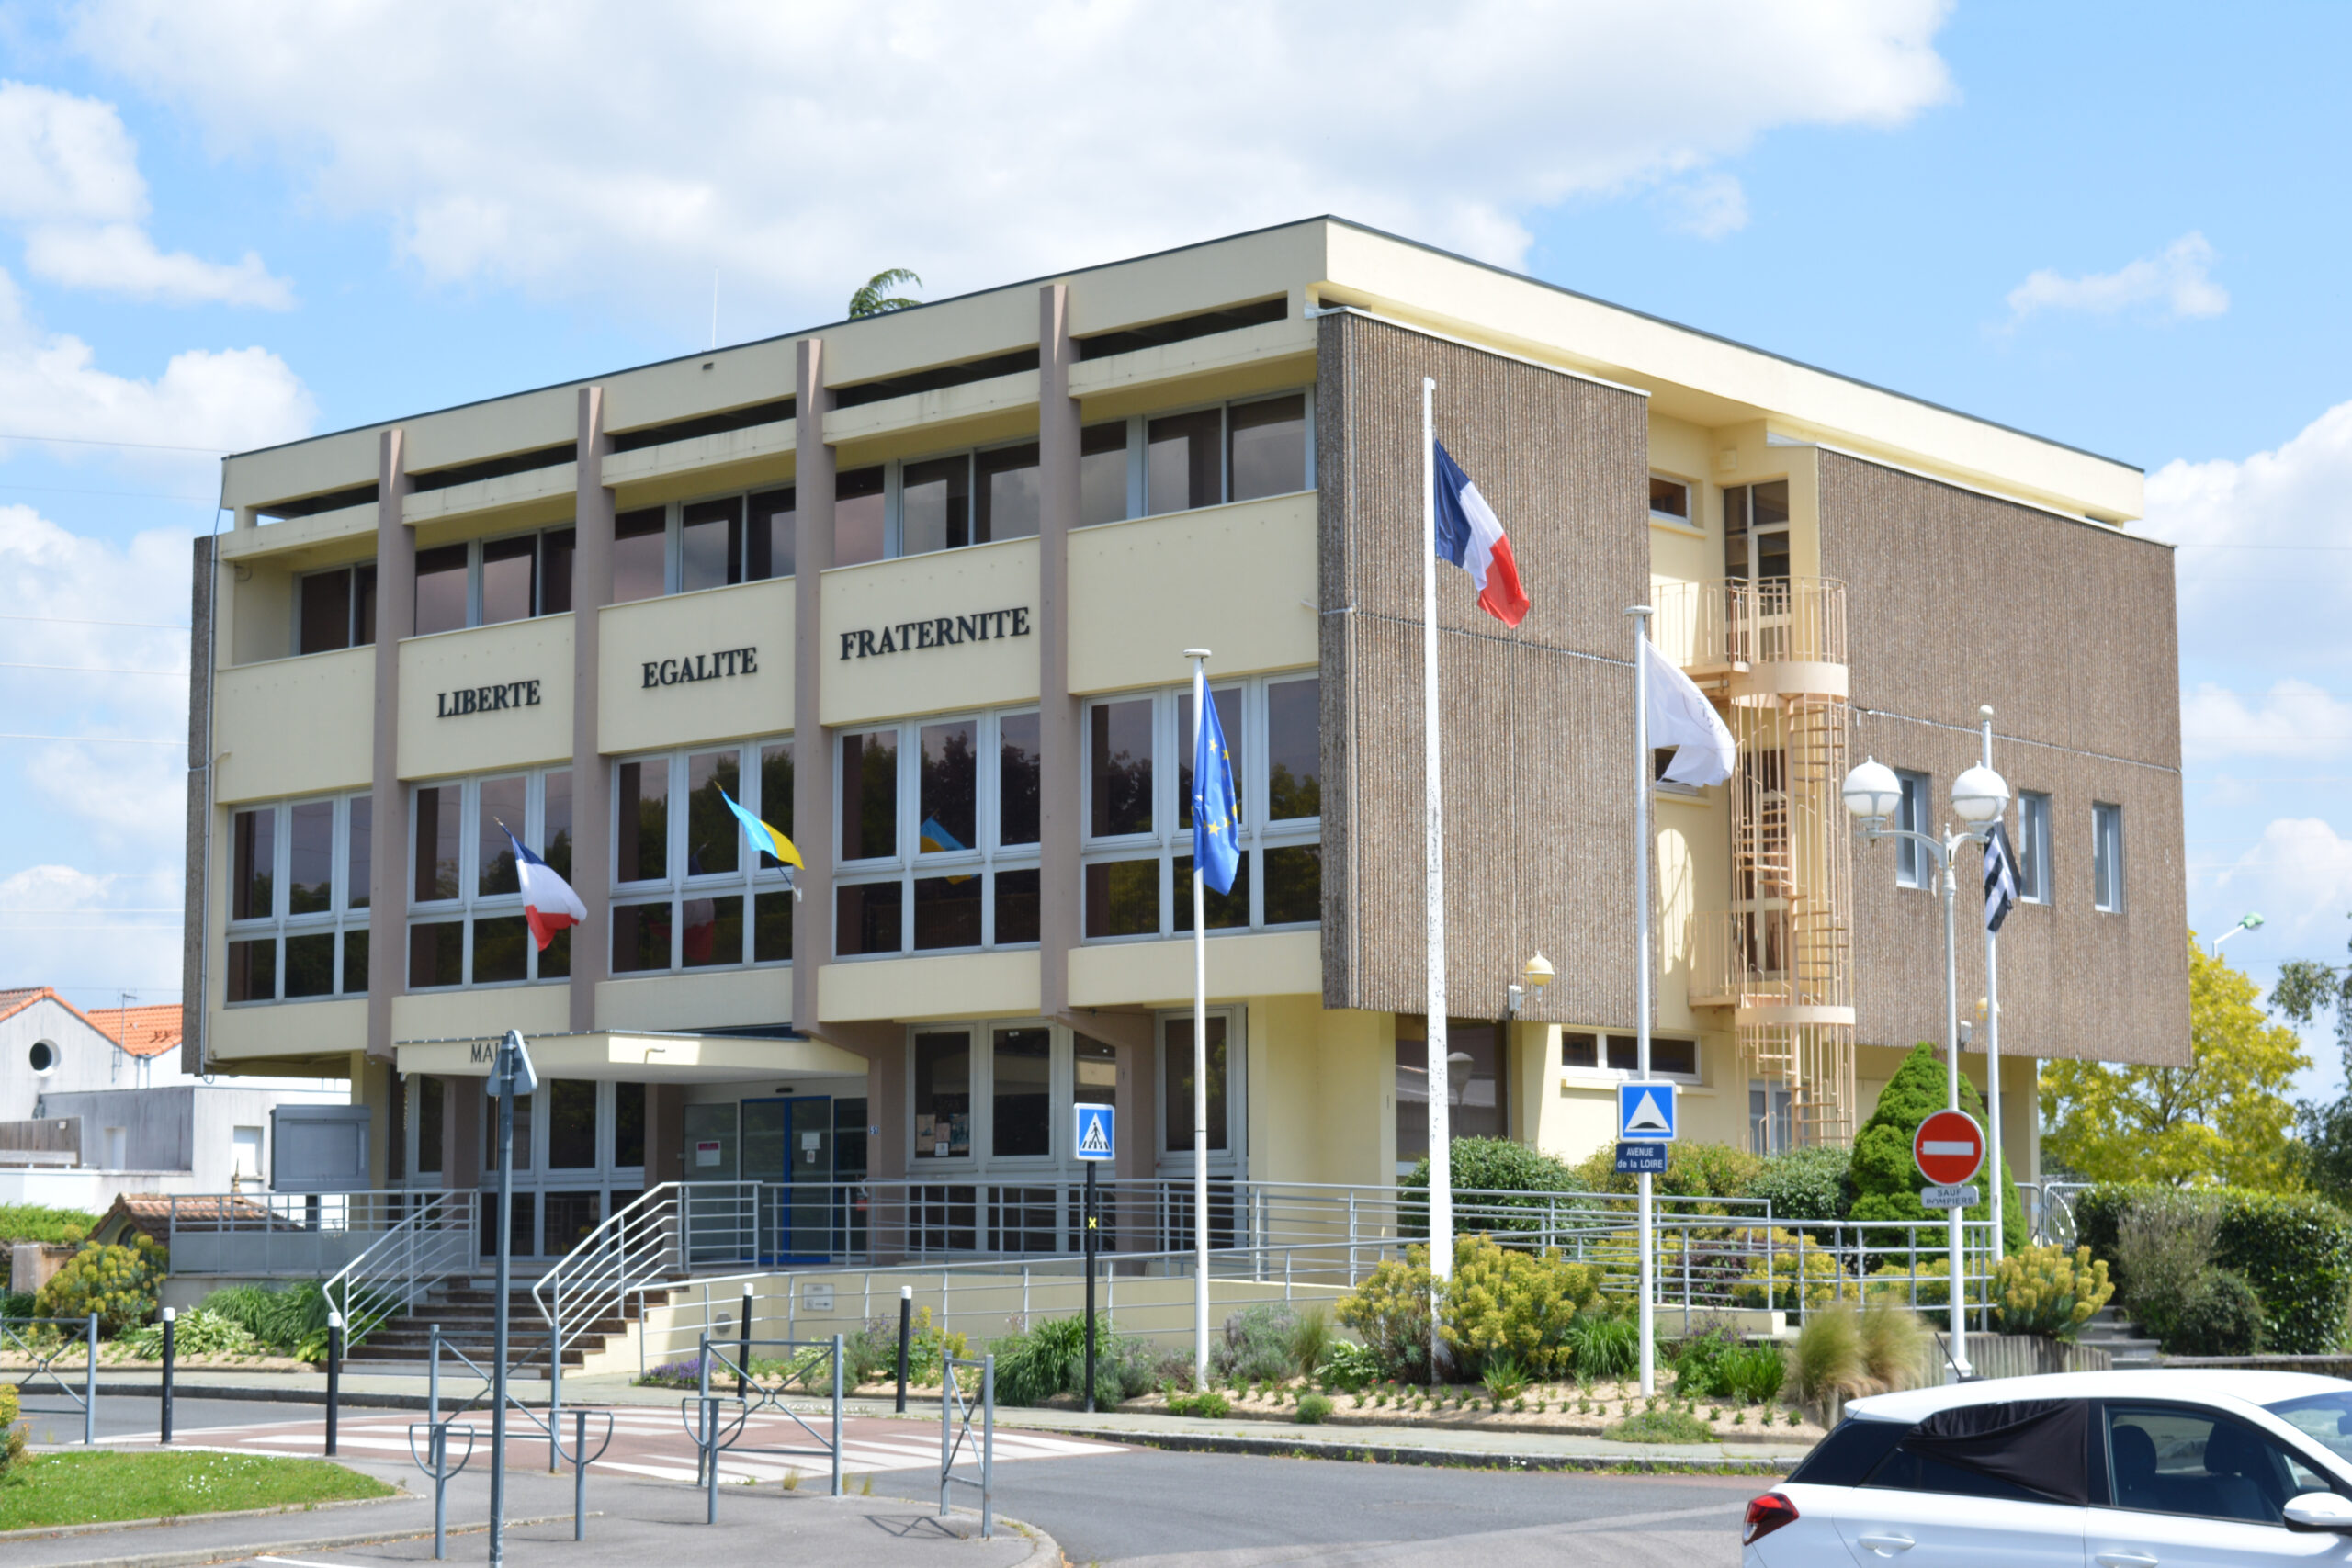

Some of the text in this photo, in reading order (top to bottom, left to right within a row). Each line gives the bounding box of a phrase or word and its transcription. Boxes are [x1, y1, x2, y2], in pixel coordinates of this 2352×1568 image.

[437, 606, 1030, 718] LIBERTE EGALITE FRATERNITE
[869, 1126, 878, 1135] 51
[1626, 1147, 1654, 1156] AVENUE
[1617, 1159, 1663, 1168] de la LOIRE
[1937, 1188, 1962, 1197] SAUF
[1926, 1197, 1973, 1205] POMPIERS
